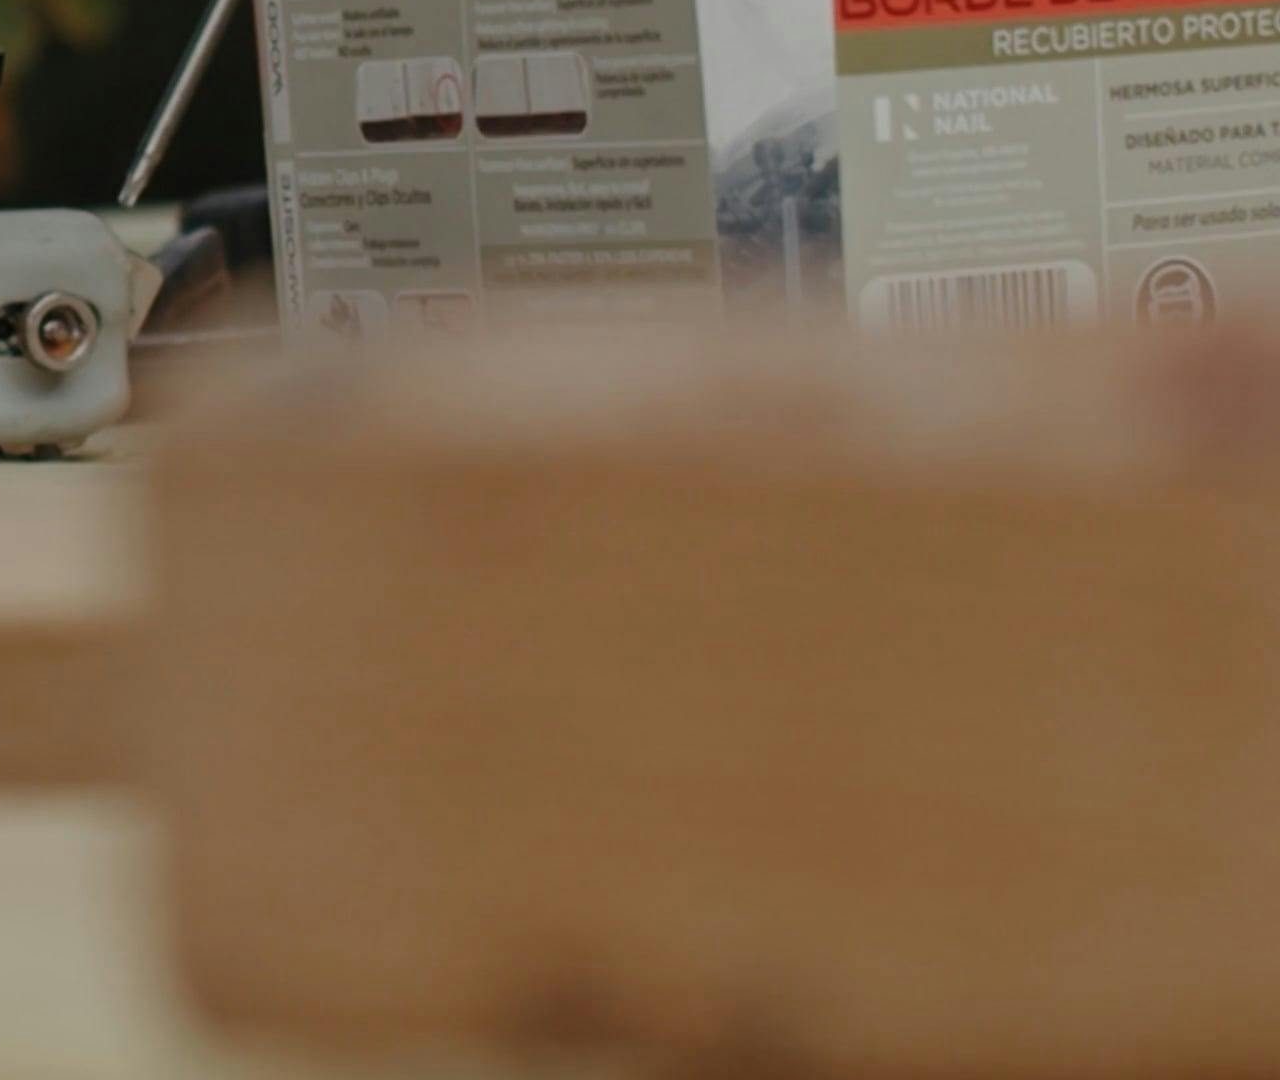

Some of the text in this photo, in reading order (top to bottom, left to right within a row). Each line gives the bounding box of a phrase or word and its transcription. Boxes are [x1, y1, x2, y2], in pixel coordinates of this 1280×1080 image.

[992, 16, 1176, 59] RECUBIERTO
[932, 83, 1060, 111] NATIONAL
[1109, 79, 1195, 101] HERMOSA
[933, 112, 994, 136] NAIL
[1124, 125, 1216, 151] DISEÑADO
[1219, 123, 1266, 140] PARA
[1148, 154, 1235, 175] MATERIAL
